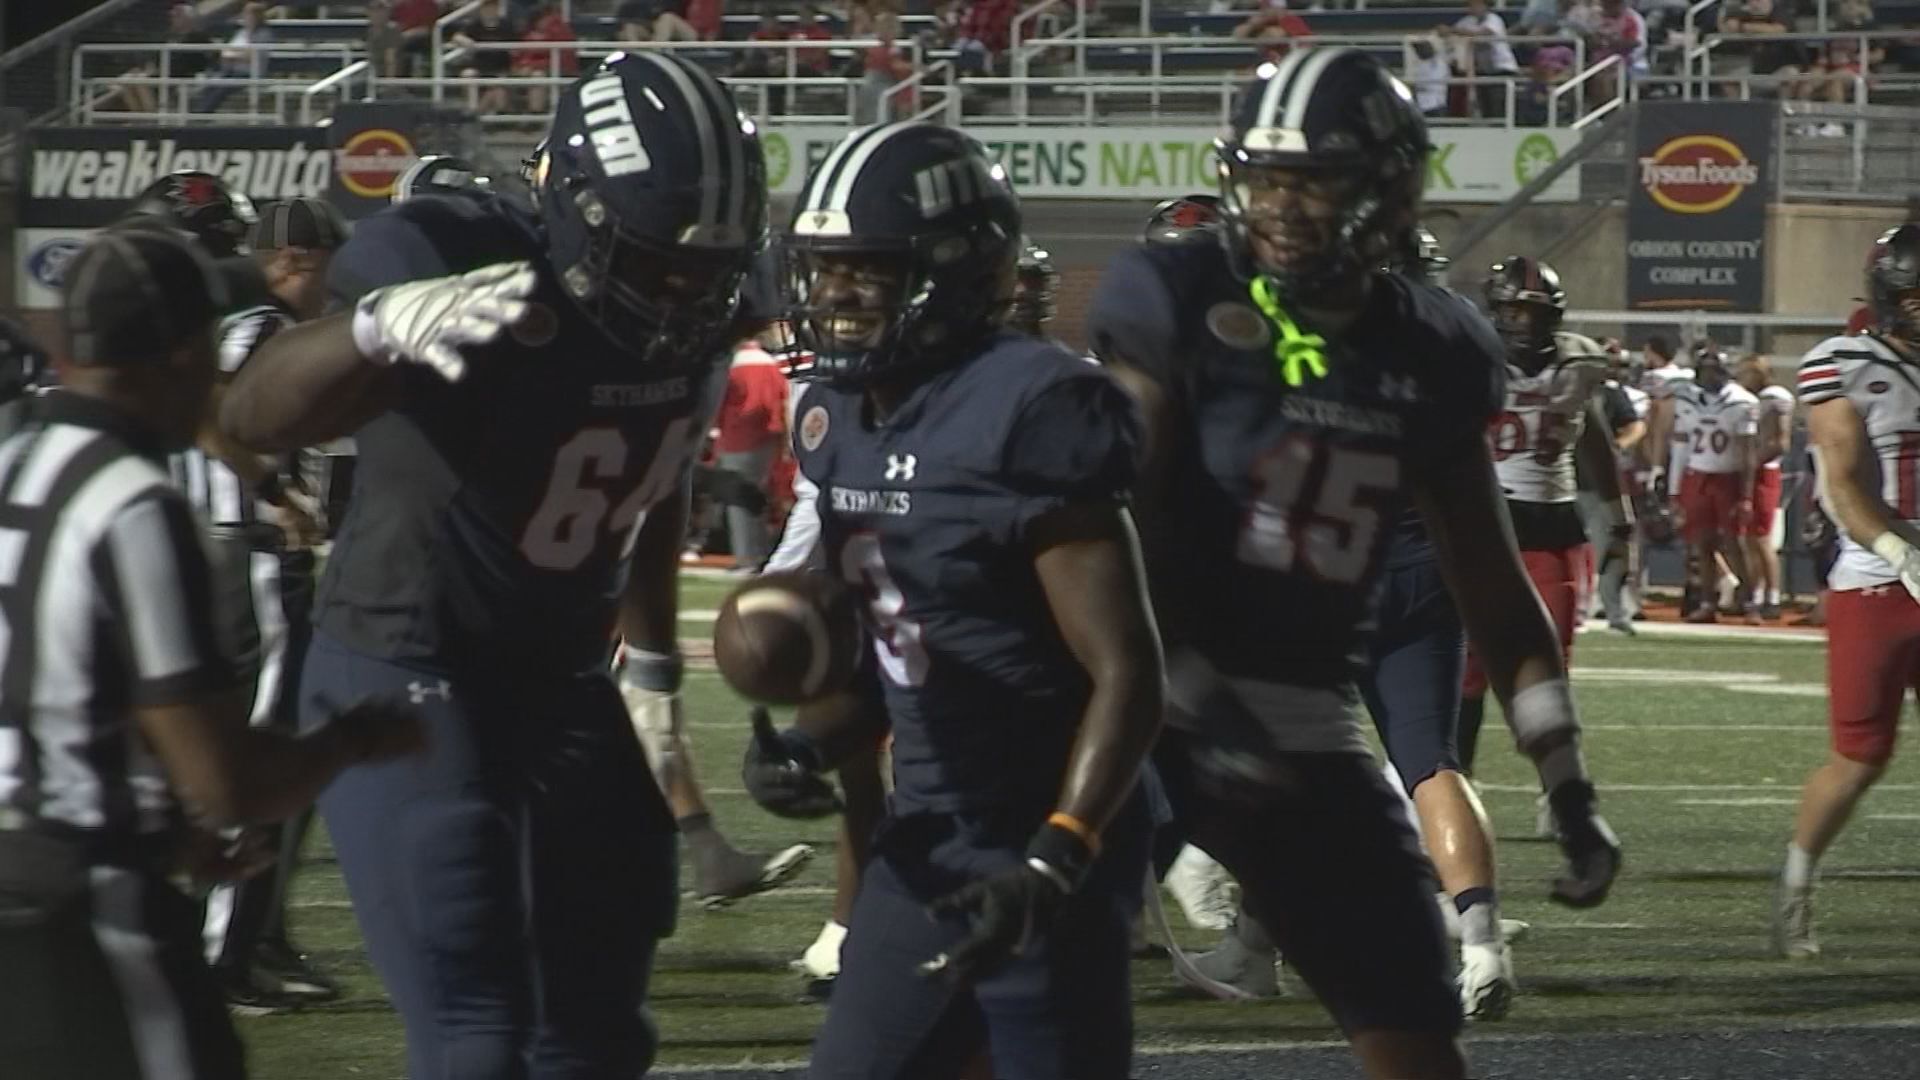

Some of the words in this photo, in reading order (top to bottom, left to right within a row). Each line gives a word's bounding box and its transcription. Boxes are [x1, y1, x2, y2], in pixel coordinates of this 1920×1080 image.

[1101, 142, 1220, 188] NATIO
[1687, 239, 1761, 259] COUNTY
[1649, 267, 1738, 286] COMPLEX
[1234, 436, 1399, 581] 15
